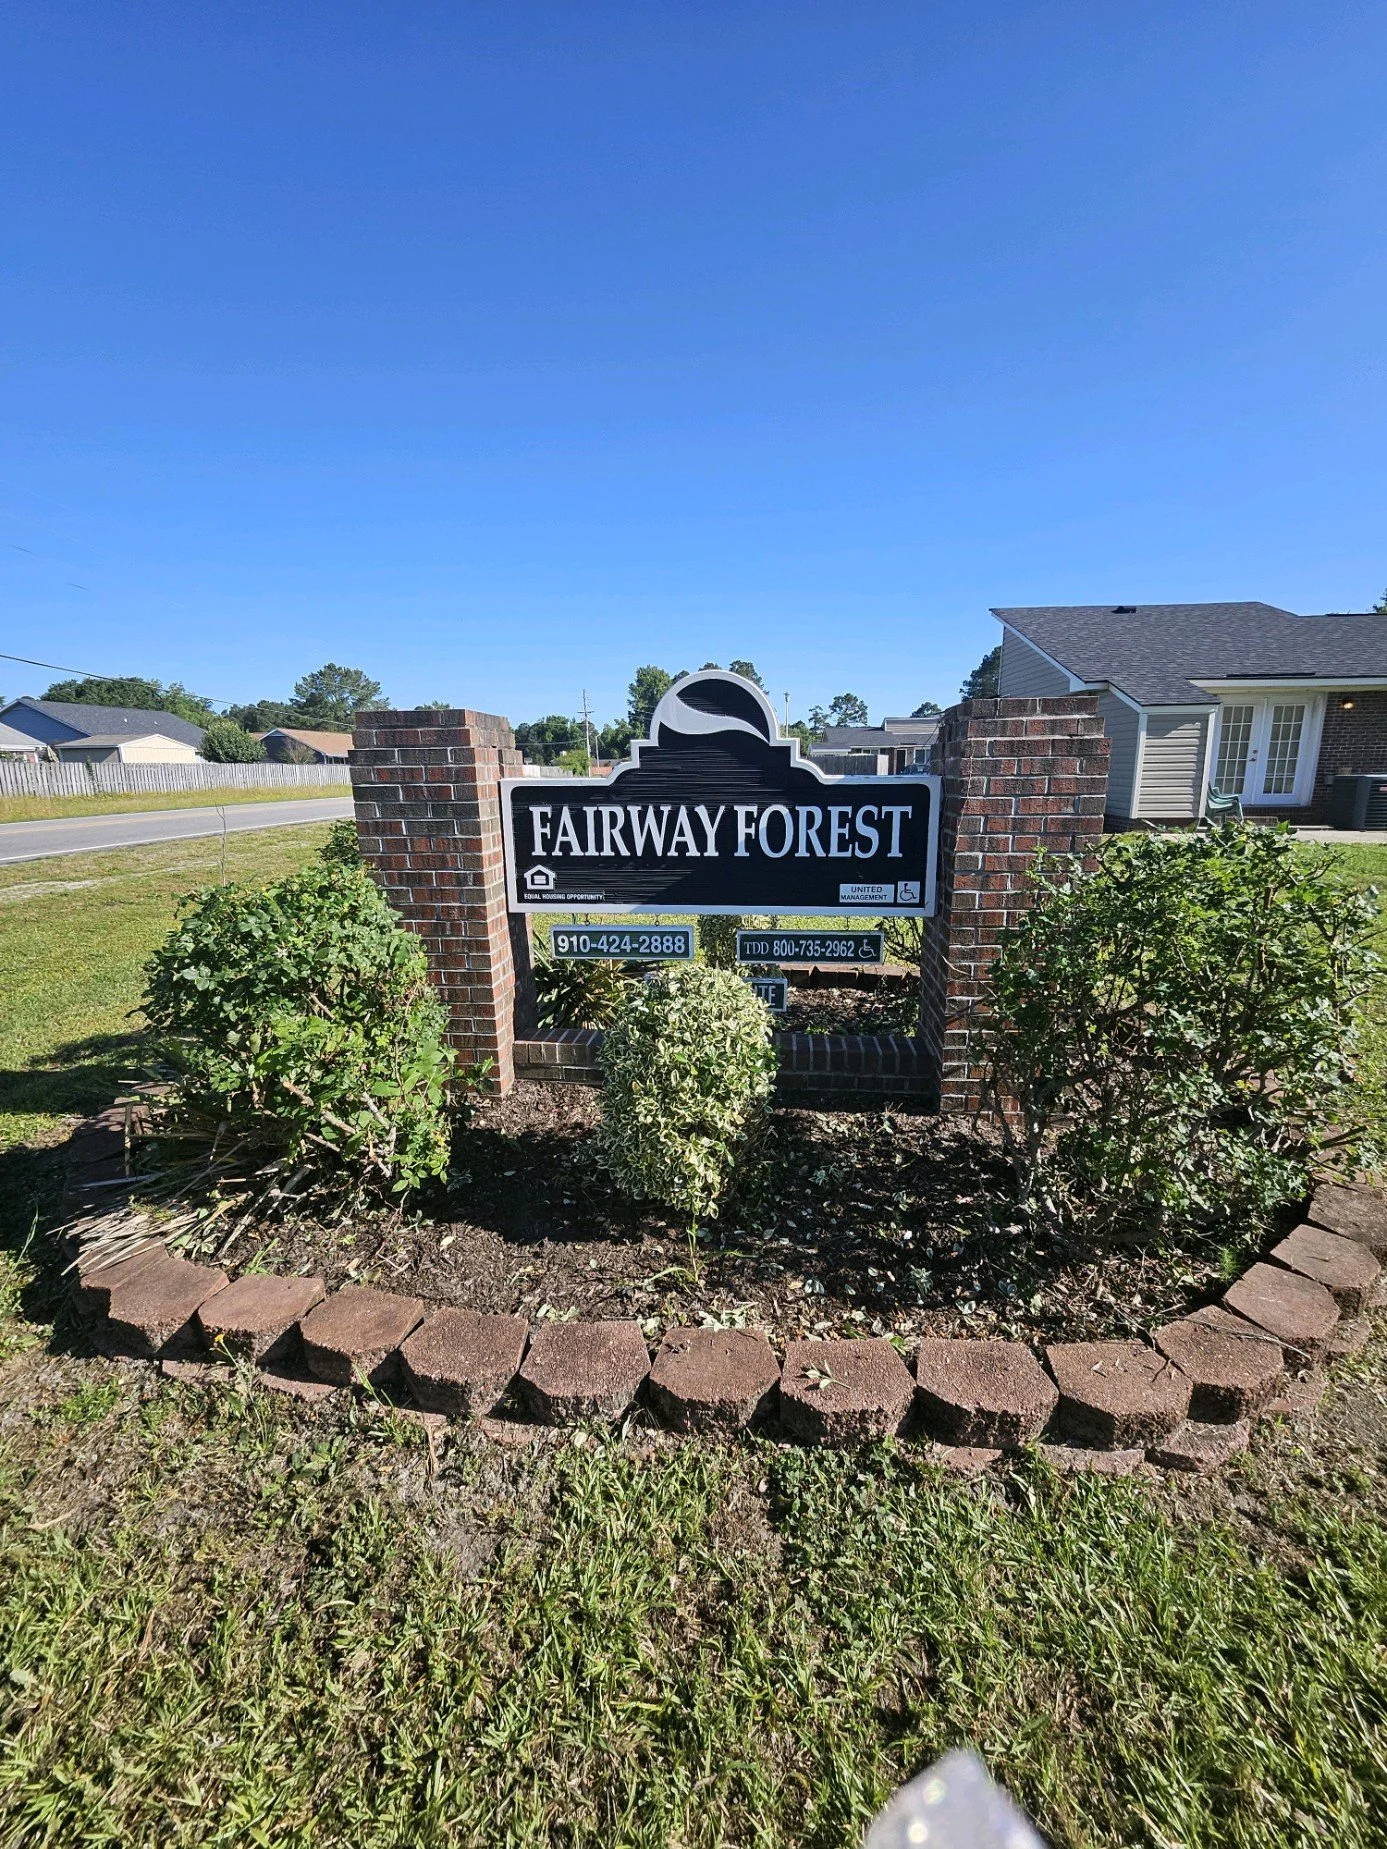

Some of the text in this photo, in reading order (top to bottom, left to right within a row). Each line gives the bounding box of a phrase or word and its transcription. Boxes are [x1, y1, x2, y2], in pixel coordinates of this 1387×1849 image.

[528, 804, 912, 859] FAIRWAY FOREST
[557, 935, 686, 954] 910-424-2888
[744, 939, 855, 957] TDD 800-735-2962
